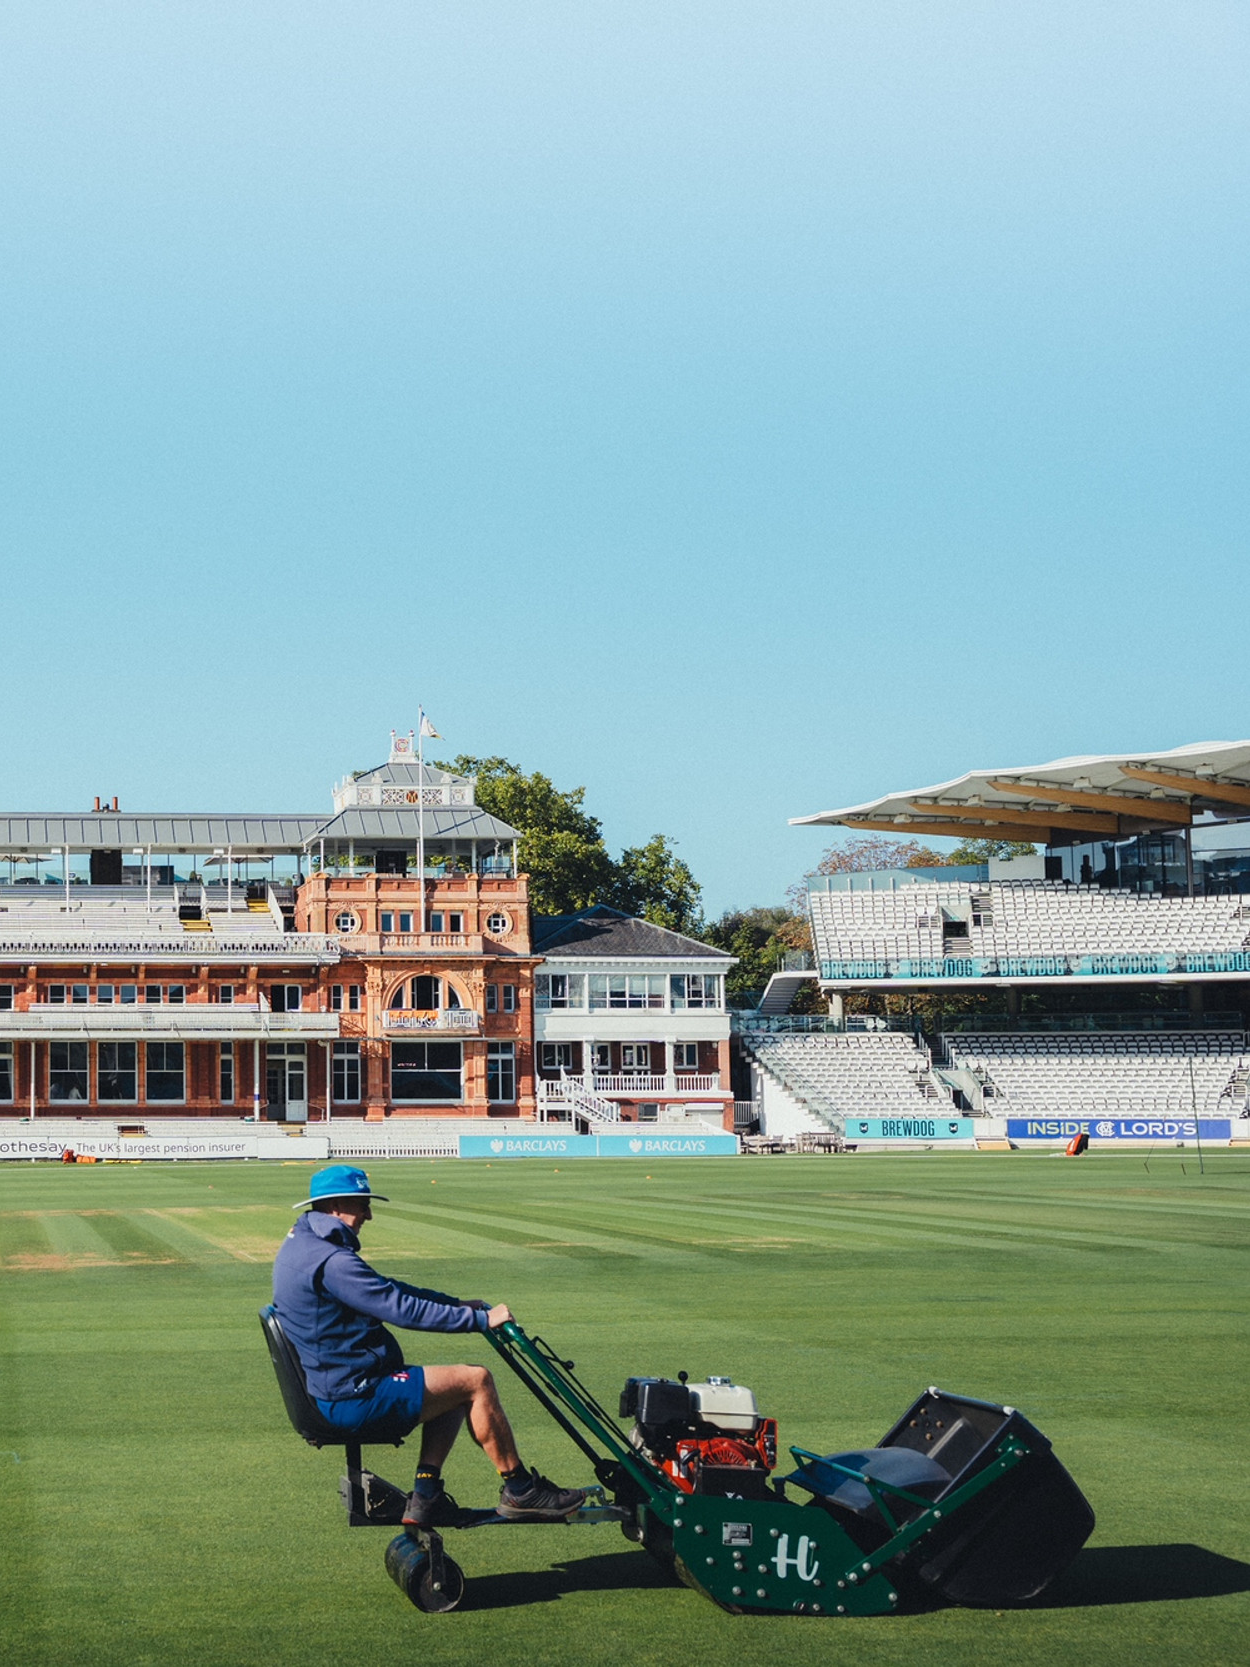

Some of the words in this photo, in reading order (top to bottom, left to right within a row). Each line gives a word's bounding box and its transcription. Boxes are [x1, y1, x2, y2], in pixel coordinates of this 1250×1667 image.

[822, 961, 885, 979] BREWDOG
[910, 958, 972, 977] BREWDOG
[1000, 958, 1064, 976] BREWDOG
[1092, 954, 1158, 974] BREWDOG
[882, 1120, 935, 1137] BREWDOG
[1120, 1122, 1197, 1136] LORD'S
[76, 1142, 96, 1153] The
[99, 1142, 121, 1153] UK's
[124, 1142, 161, 1155] largest
[163, 1142, 206, 1155] pension
[208, 1142, 246, 1153] insurer
[506, 1140, 567, 1152] BARCLAYS
[645, 1140, 706, 1152] BARCLAYS
